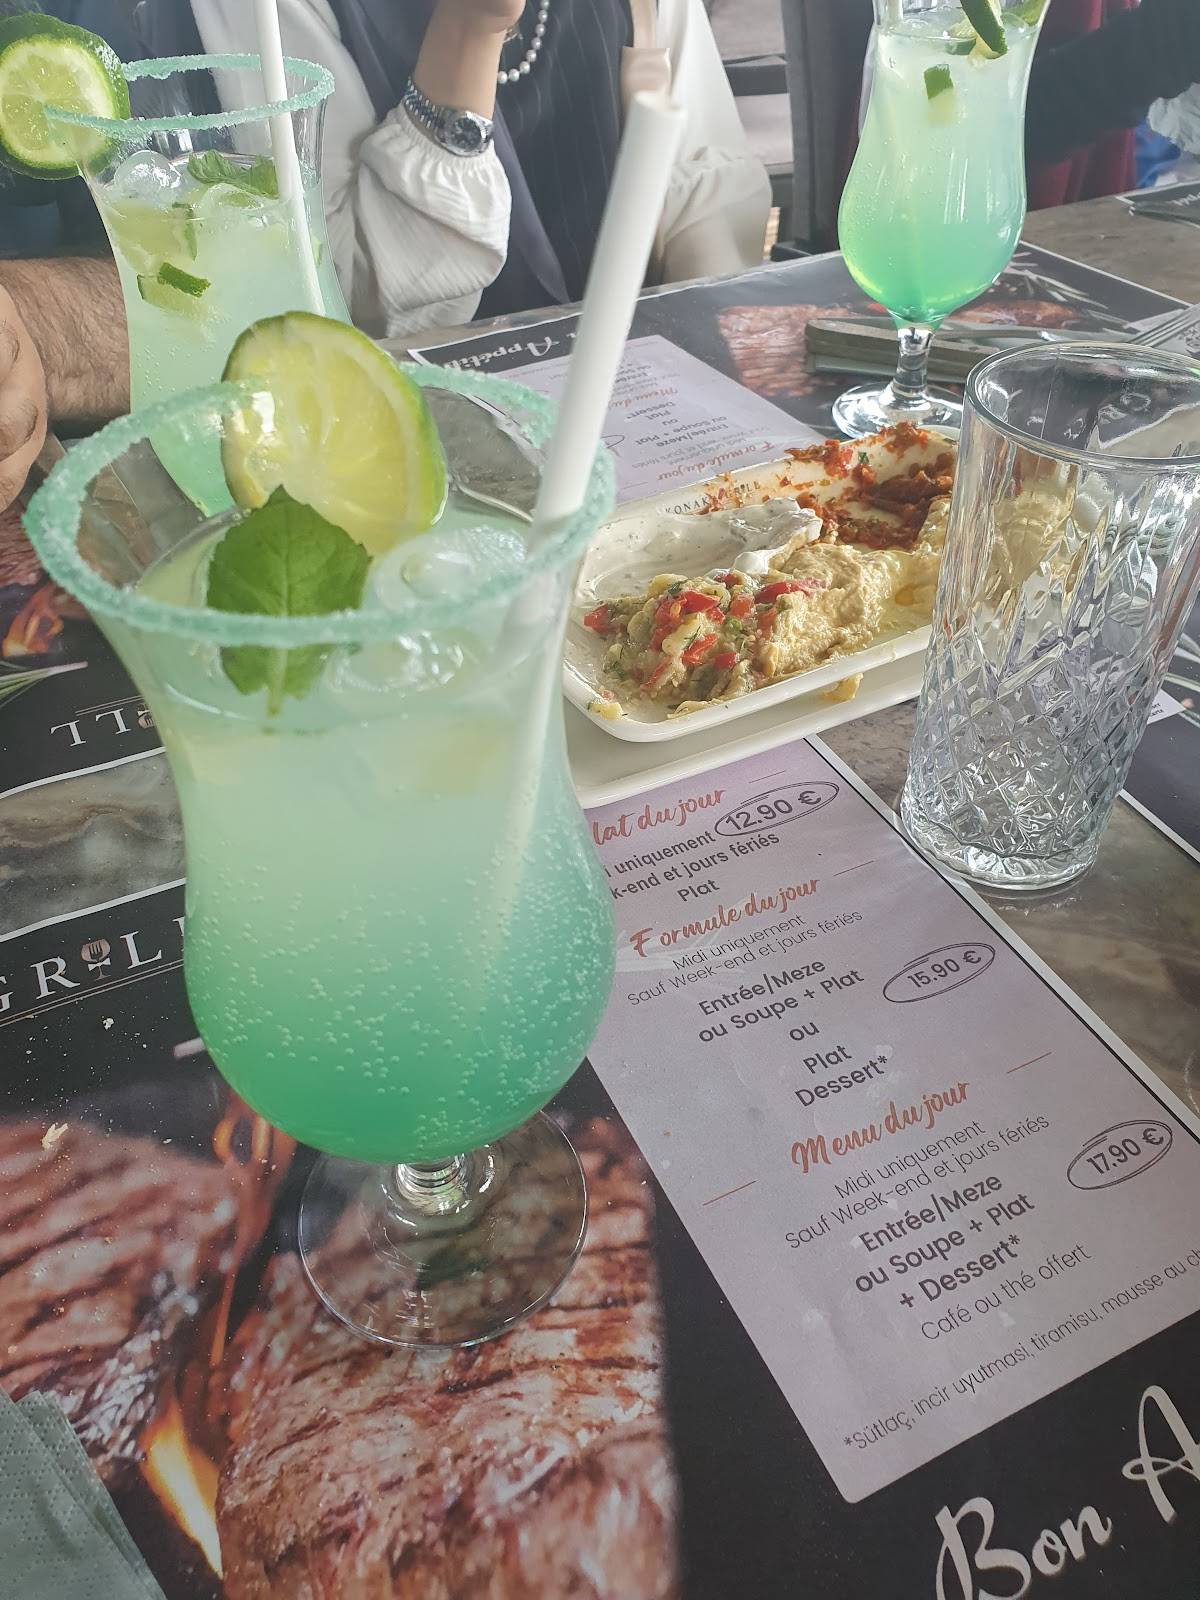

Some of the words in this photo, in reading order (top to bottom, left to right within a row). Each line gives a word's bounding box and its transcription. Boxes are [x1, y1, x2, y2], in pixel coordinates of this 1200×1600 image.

[592, 812, 636, 846] lat
[725, 798, 793, 832] 12.90
[797, 790, 822, 806] €
[610, 873, 662, 900] k-end
[663, 865, 684, 881] et
[684, 852, 729, 879] jours
[728, 831, 780, 858] fériés
[613, 831, 717, 876] uniquement
[676, 878, 720, 902] Plat
[627, 982, 668, 1006] Sauf
[668, 950, 757, 990] Week-end
[758, 943, 777, 960] et
[776, 926, 818, 956] jours
[817, 909, 864, 936] fériés
[629, 907, 742, 958] Formule
[672, 947, 707, 970] Midi
[711, 914, 806, 961] uniquement
[698, 958, 827, 1016] Entrée/Meze
[906, 957, 960, 989] 15.90
[962, 949, 982, 966] €
[698, 1022, 728, 1042] ou
[730, 996, 799, 1031] Soupe
[803, 988, 816, 1001] +
[821, 968, 865, 994] Plat
[788, 1021, 820, 1042] ou
[802, 1044, 853, 1075] Plat
[790, 1123, 883, 1174] Menu
[883, 1100, 925, 1136] du
[920, 1081, 971, 1130] jour
[1086, 1137, 1142, 1176] 17.90
[1142, 1126, 1165, 1146] €
[785, 1217, 833, 1249] Sauf
[830, 1169, 933, 1226] Week-end
[936, 1161, 954, 1179] et
[955, 1139, 1001, 1175] jours
[998, 1113, 1050, 1147] fériés
[833, 1171, 876, 1199] Midi
[880, 1119, 986, 1180] uniquement
[855, 1264, 888, 1293] ou
[888, 1226, 966, 1276] Soupe
[968, 1217, 984, 1234] +
[985, 1192, 1036, 1227] Plat
[858, 1175, 1003, 1253] Entrée/Meze
[898, 1291, 915, 1309] +
[920, 1303, 973, 1341] Café
[974, 1291, 1002, 1315] ou
[1001, 1269, 1037, 1301] thé
[1037, 1243, 1093, 1281] offert
[910, 1385, 951, 1416] incir
[1030, 1306, 1105, 1352] tiramisu,
[1100, 1273, 1164, 1315] mousse
[1163, 1260, 1188, 1279] au
[934, 1496, 1113, 1600] Bon
